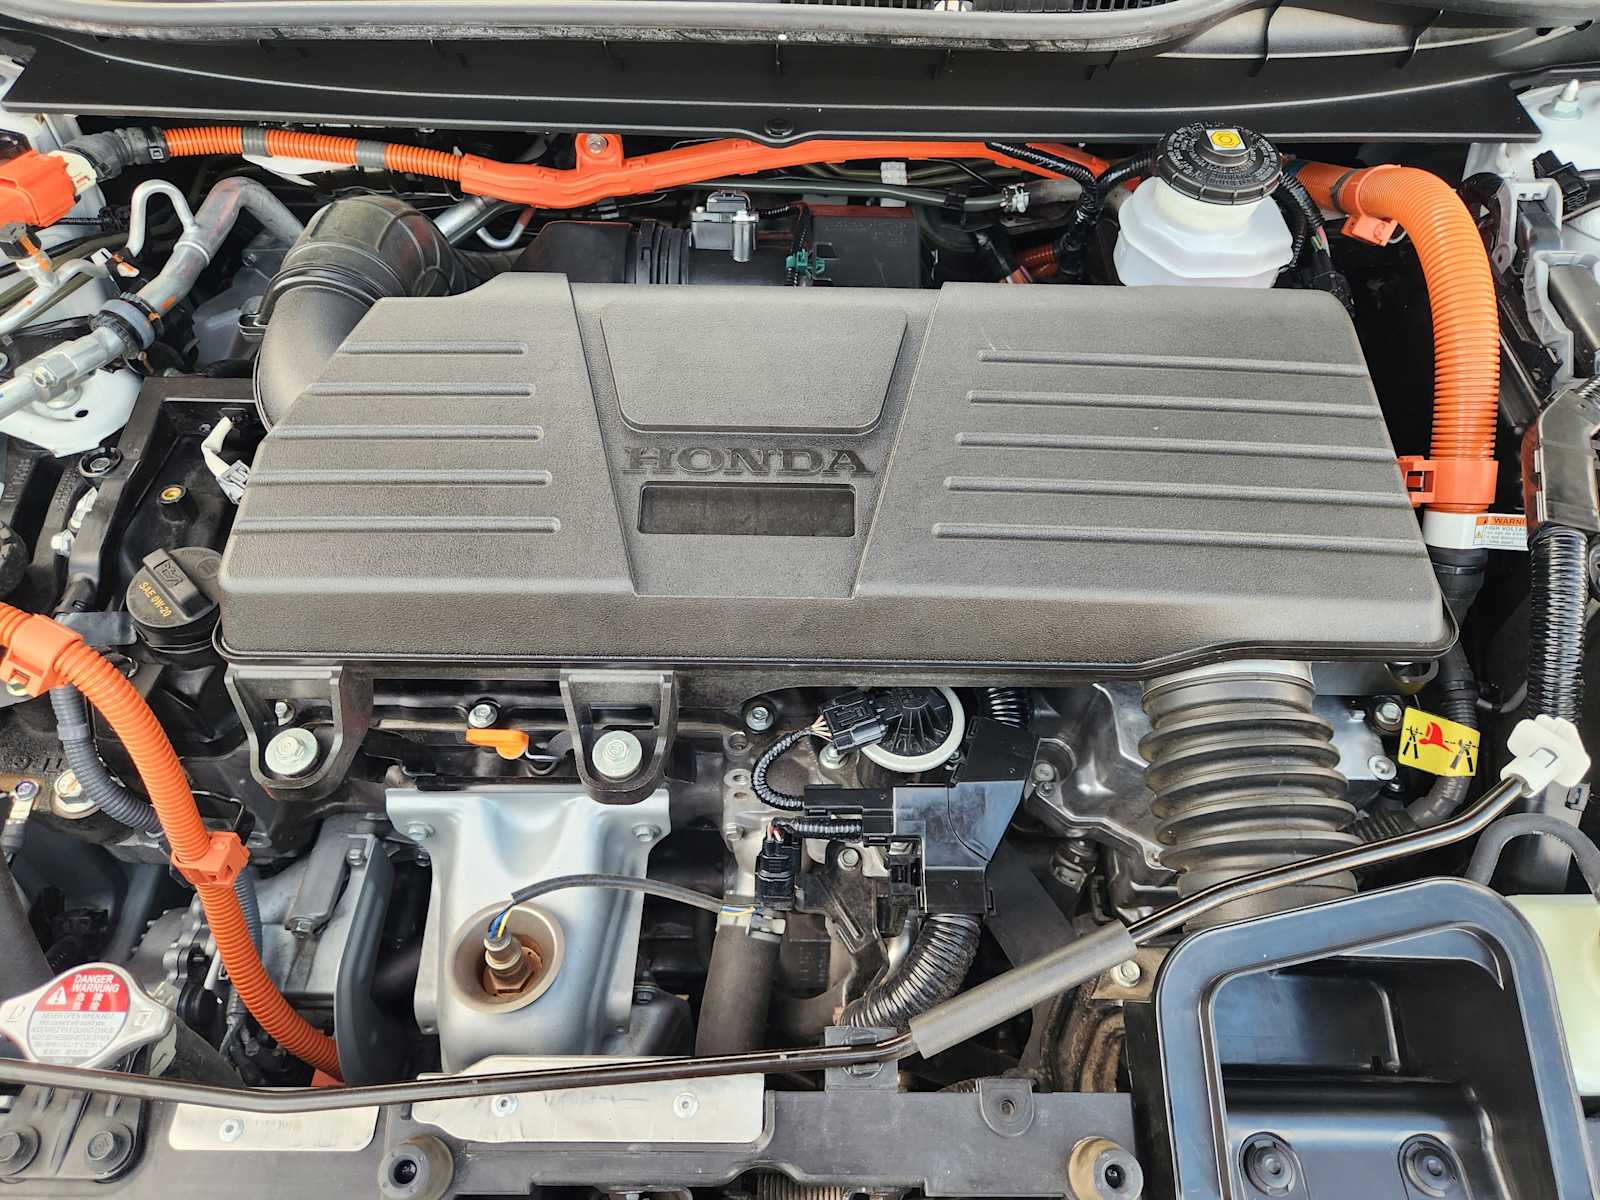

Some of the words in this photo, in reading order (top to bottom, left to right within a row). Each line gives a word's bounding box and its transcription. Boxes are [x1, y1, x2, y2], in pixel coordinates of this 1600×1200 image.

[622, 447, 876, 476] HONDA
[1494, 518, 1527, 526] WARNI
[139, 582, 155, 598] SAE
[152, 594, 172, 617] 0W-20
[74, 974, 114, 984] DANGER
[71, 983, 120, 993] WARNUNG
